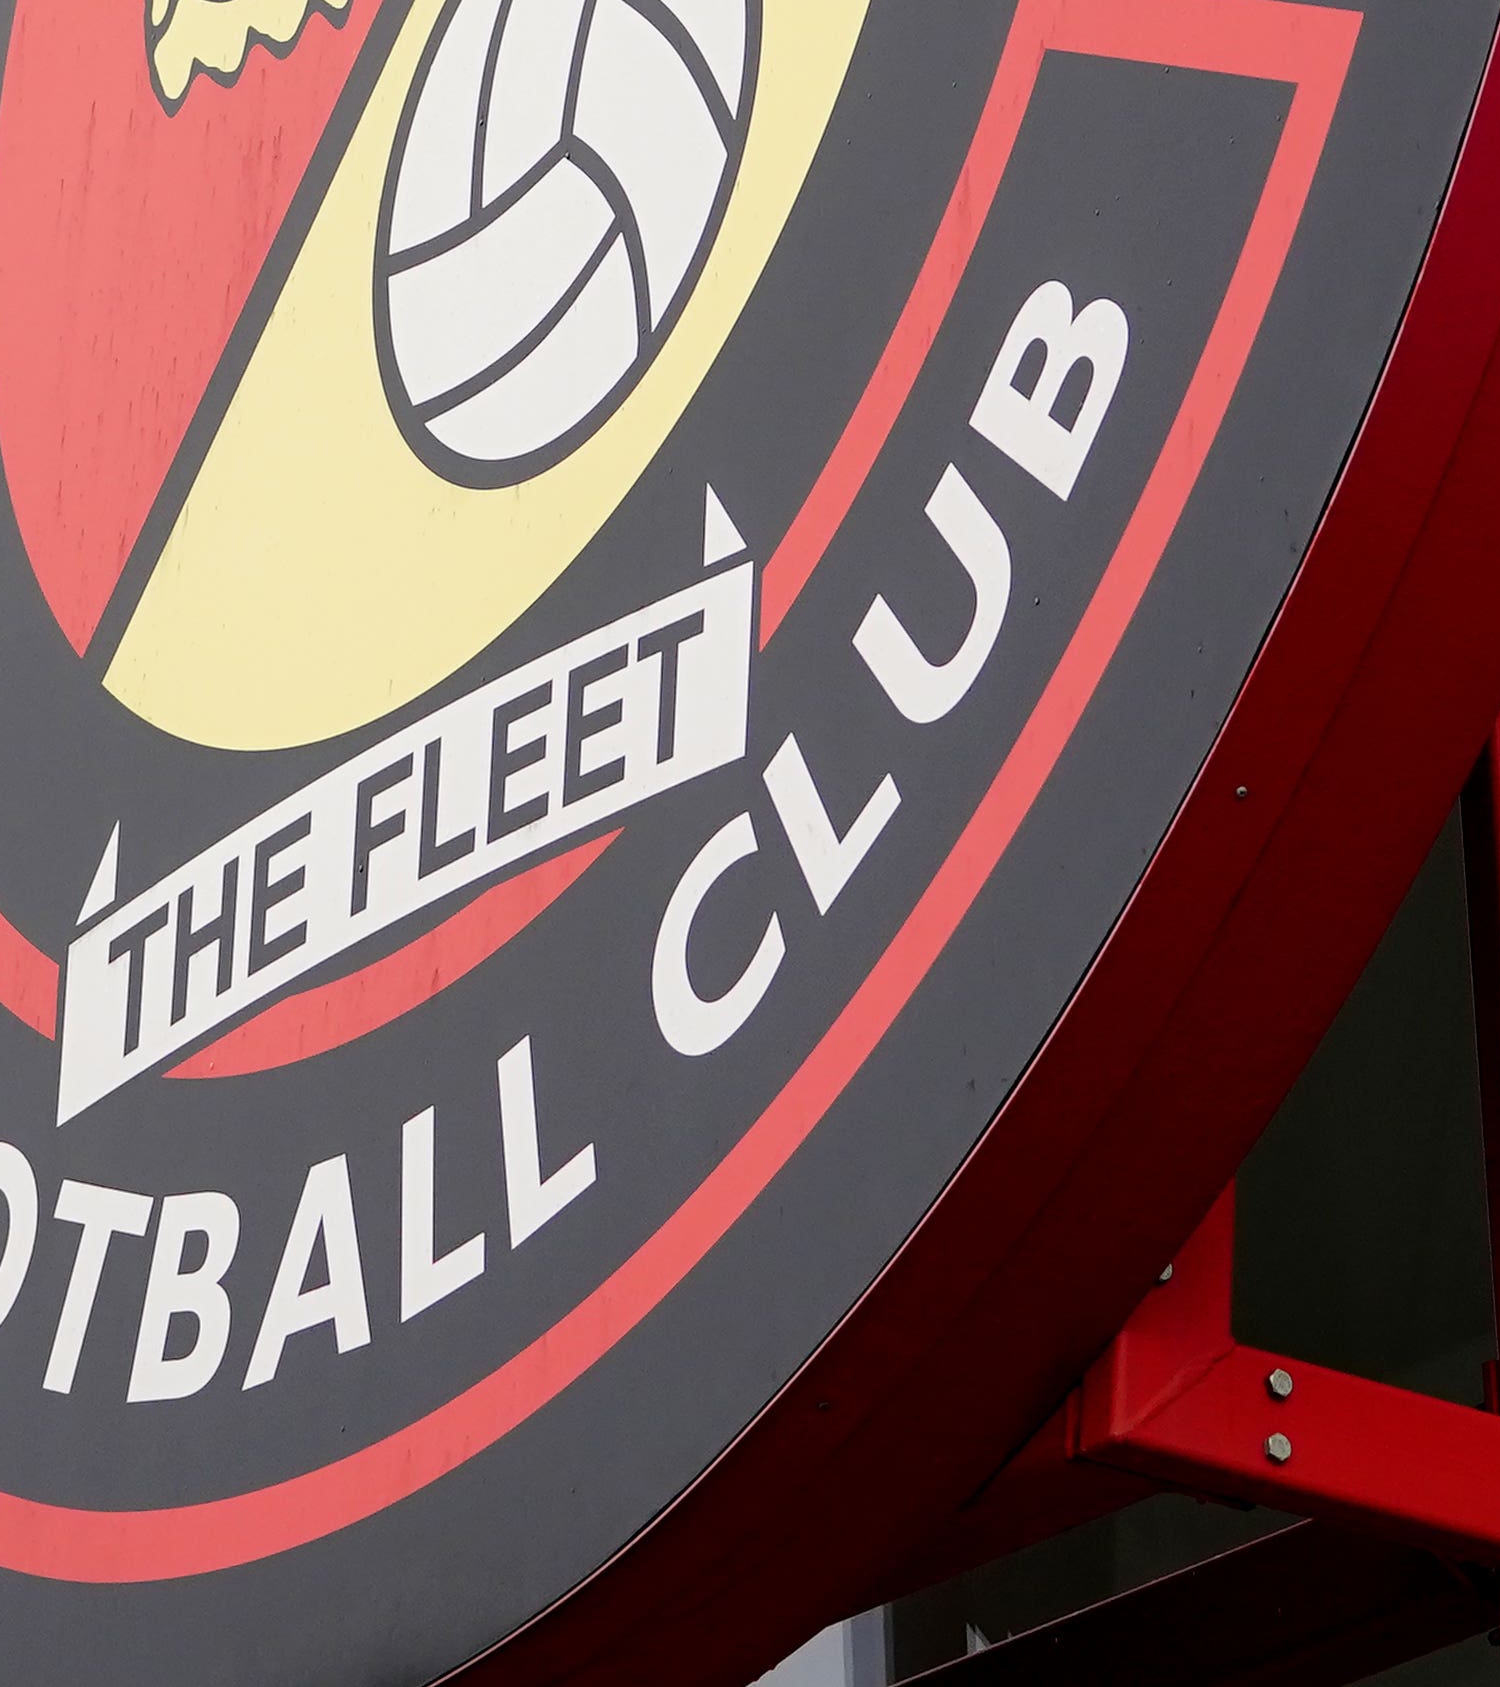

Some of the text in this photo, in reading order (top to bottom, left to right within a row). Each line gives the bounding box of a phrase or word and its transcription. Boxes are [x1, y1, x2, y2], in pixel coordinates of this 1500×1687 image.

[108, 608, 706, 1058] THE FLEET
[652, 279, 1130, 1056] CLUB
